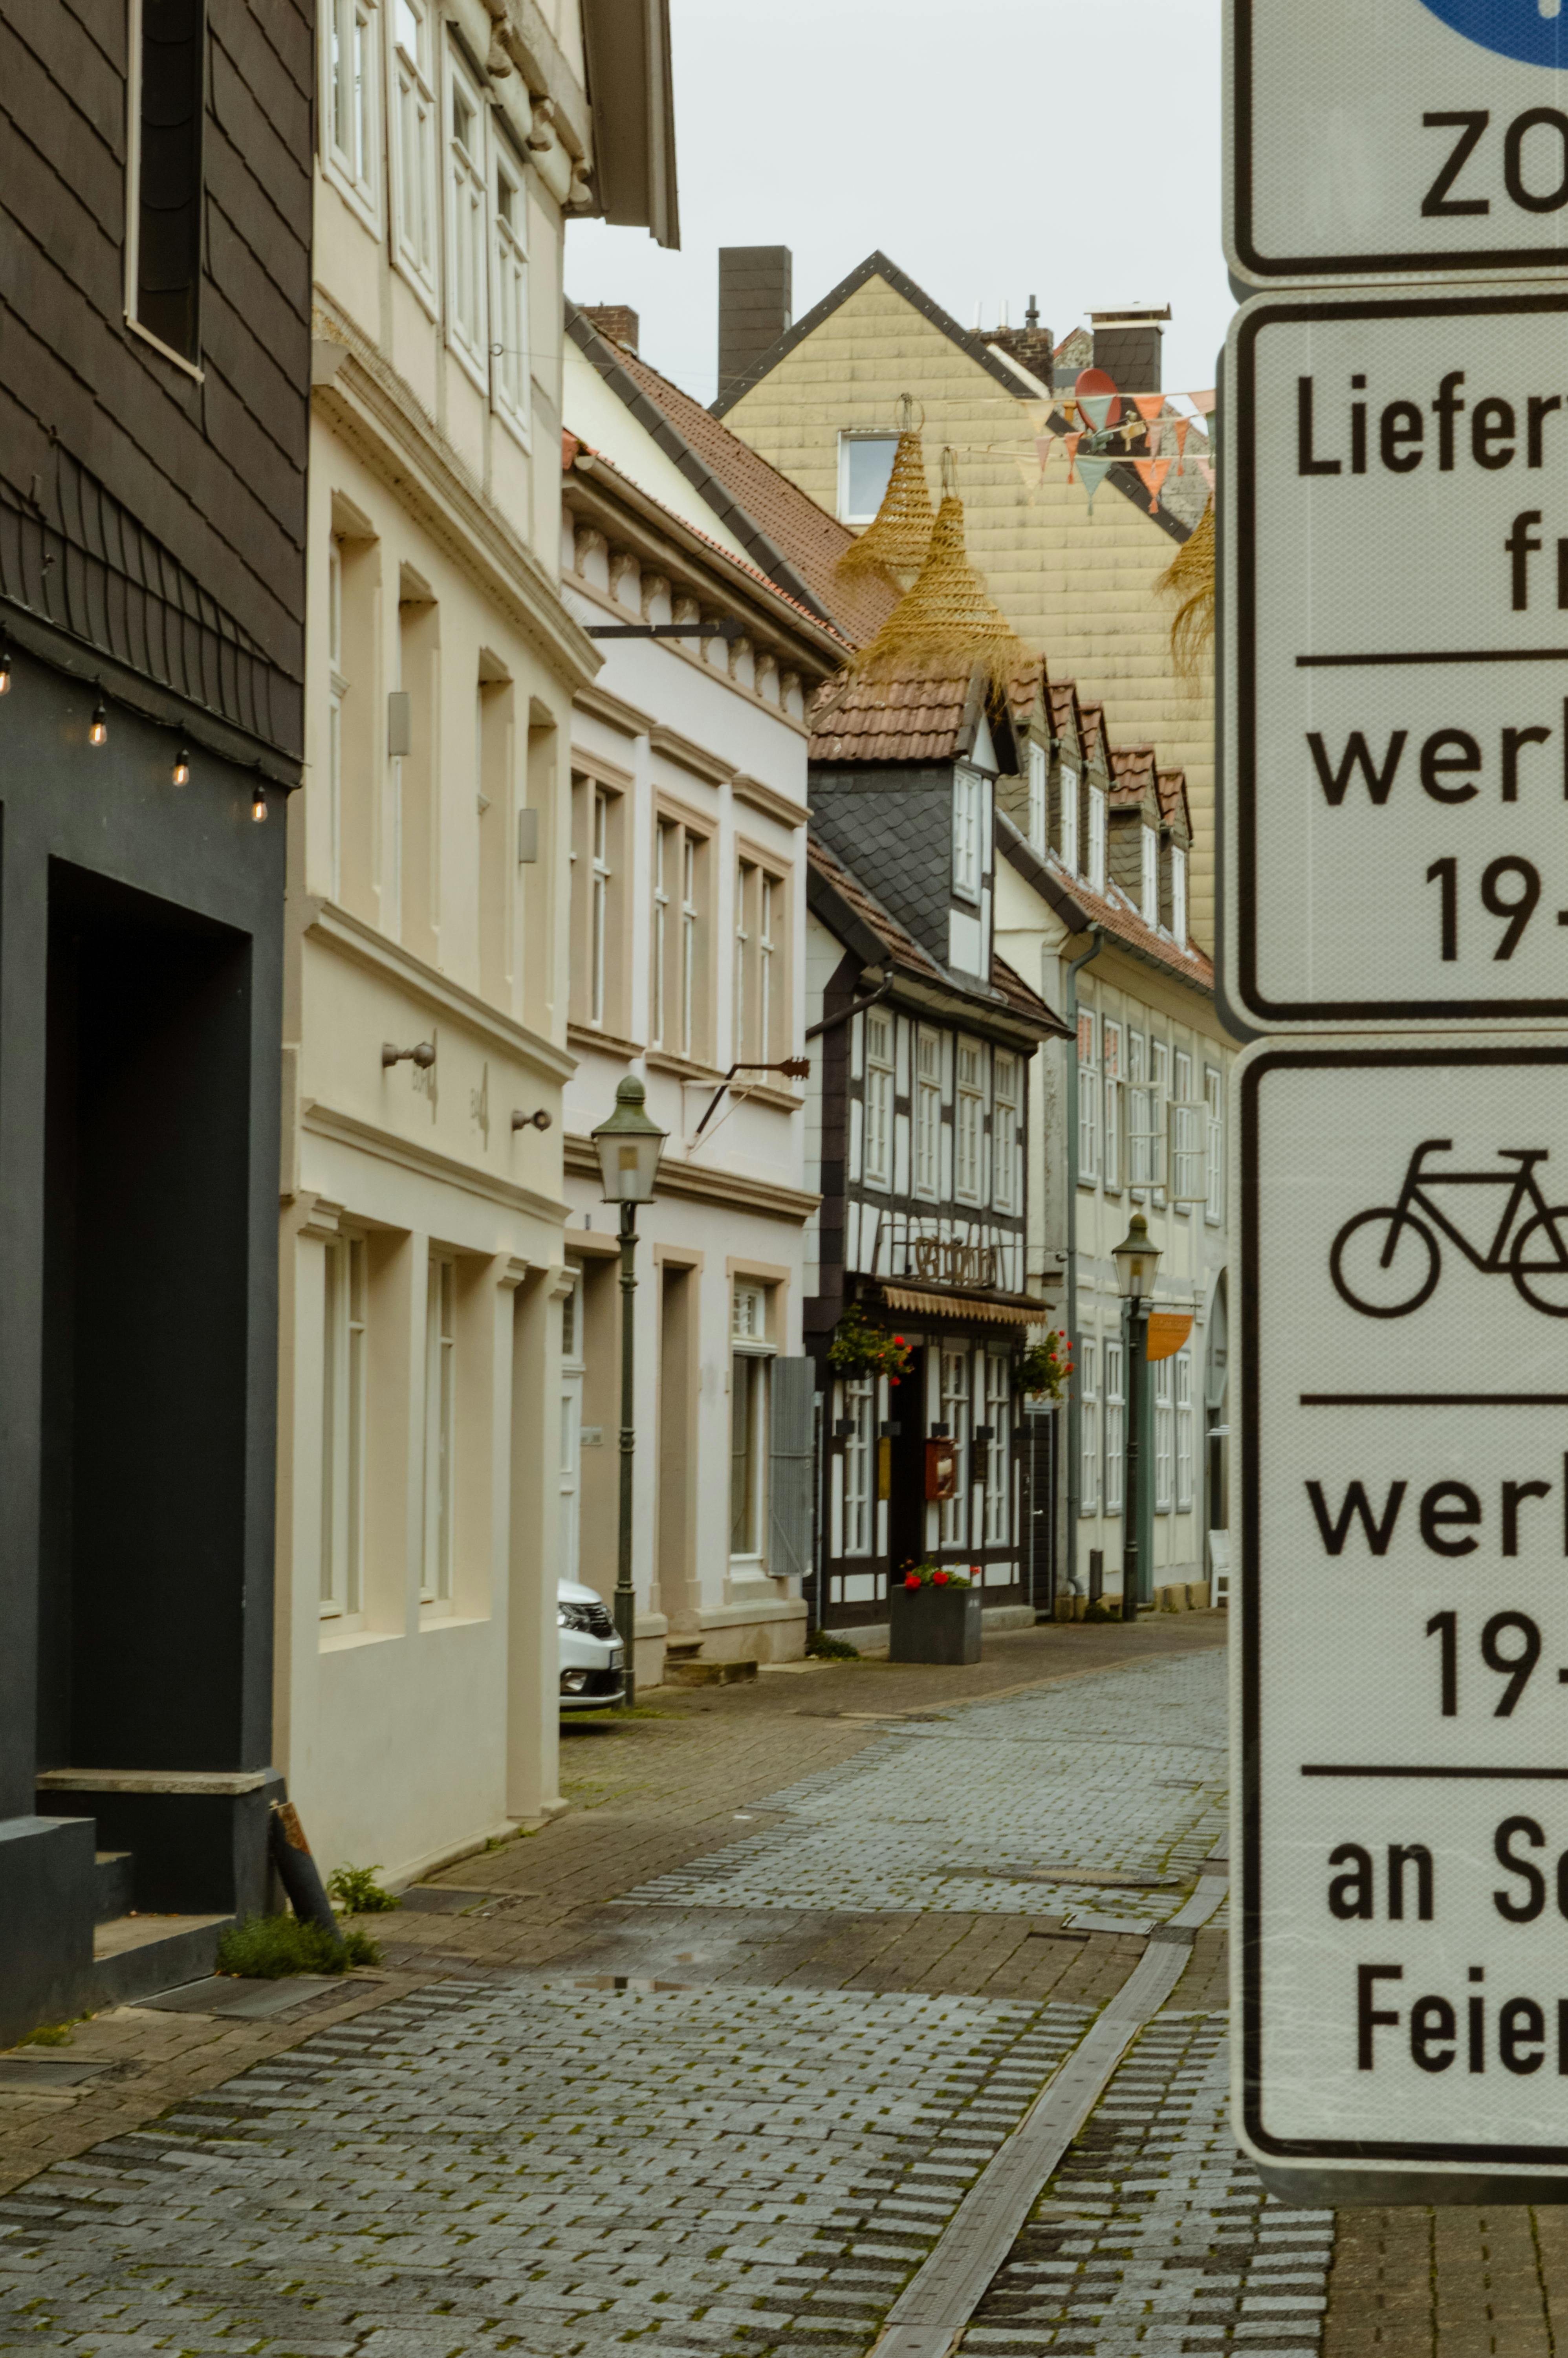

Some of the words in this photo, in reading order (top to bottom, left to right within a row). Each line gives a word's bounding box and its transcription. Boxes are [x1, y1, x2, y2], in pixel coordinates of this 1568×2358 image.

[1298, 371, 1568, 475] Liefer
[1306, 696, 1568, 805] wer
[1304, 1451, 1568, 1557] wer
[1328, 1843, 1433, 1920] an
[1494, 1816, 1568, 1923] S
[1358, 1964, 1568, 2075] Feie
